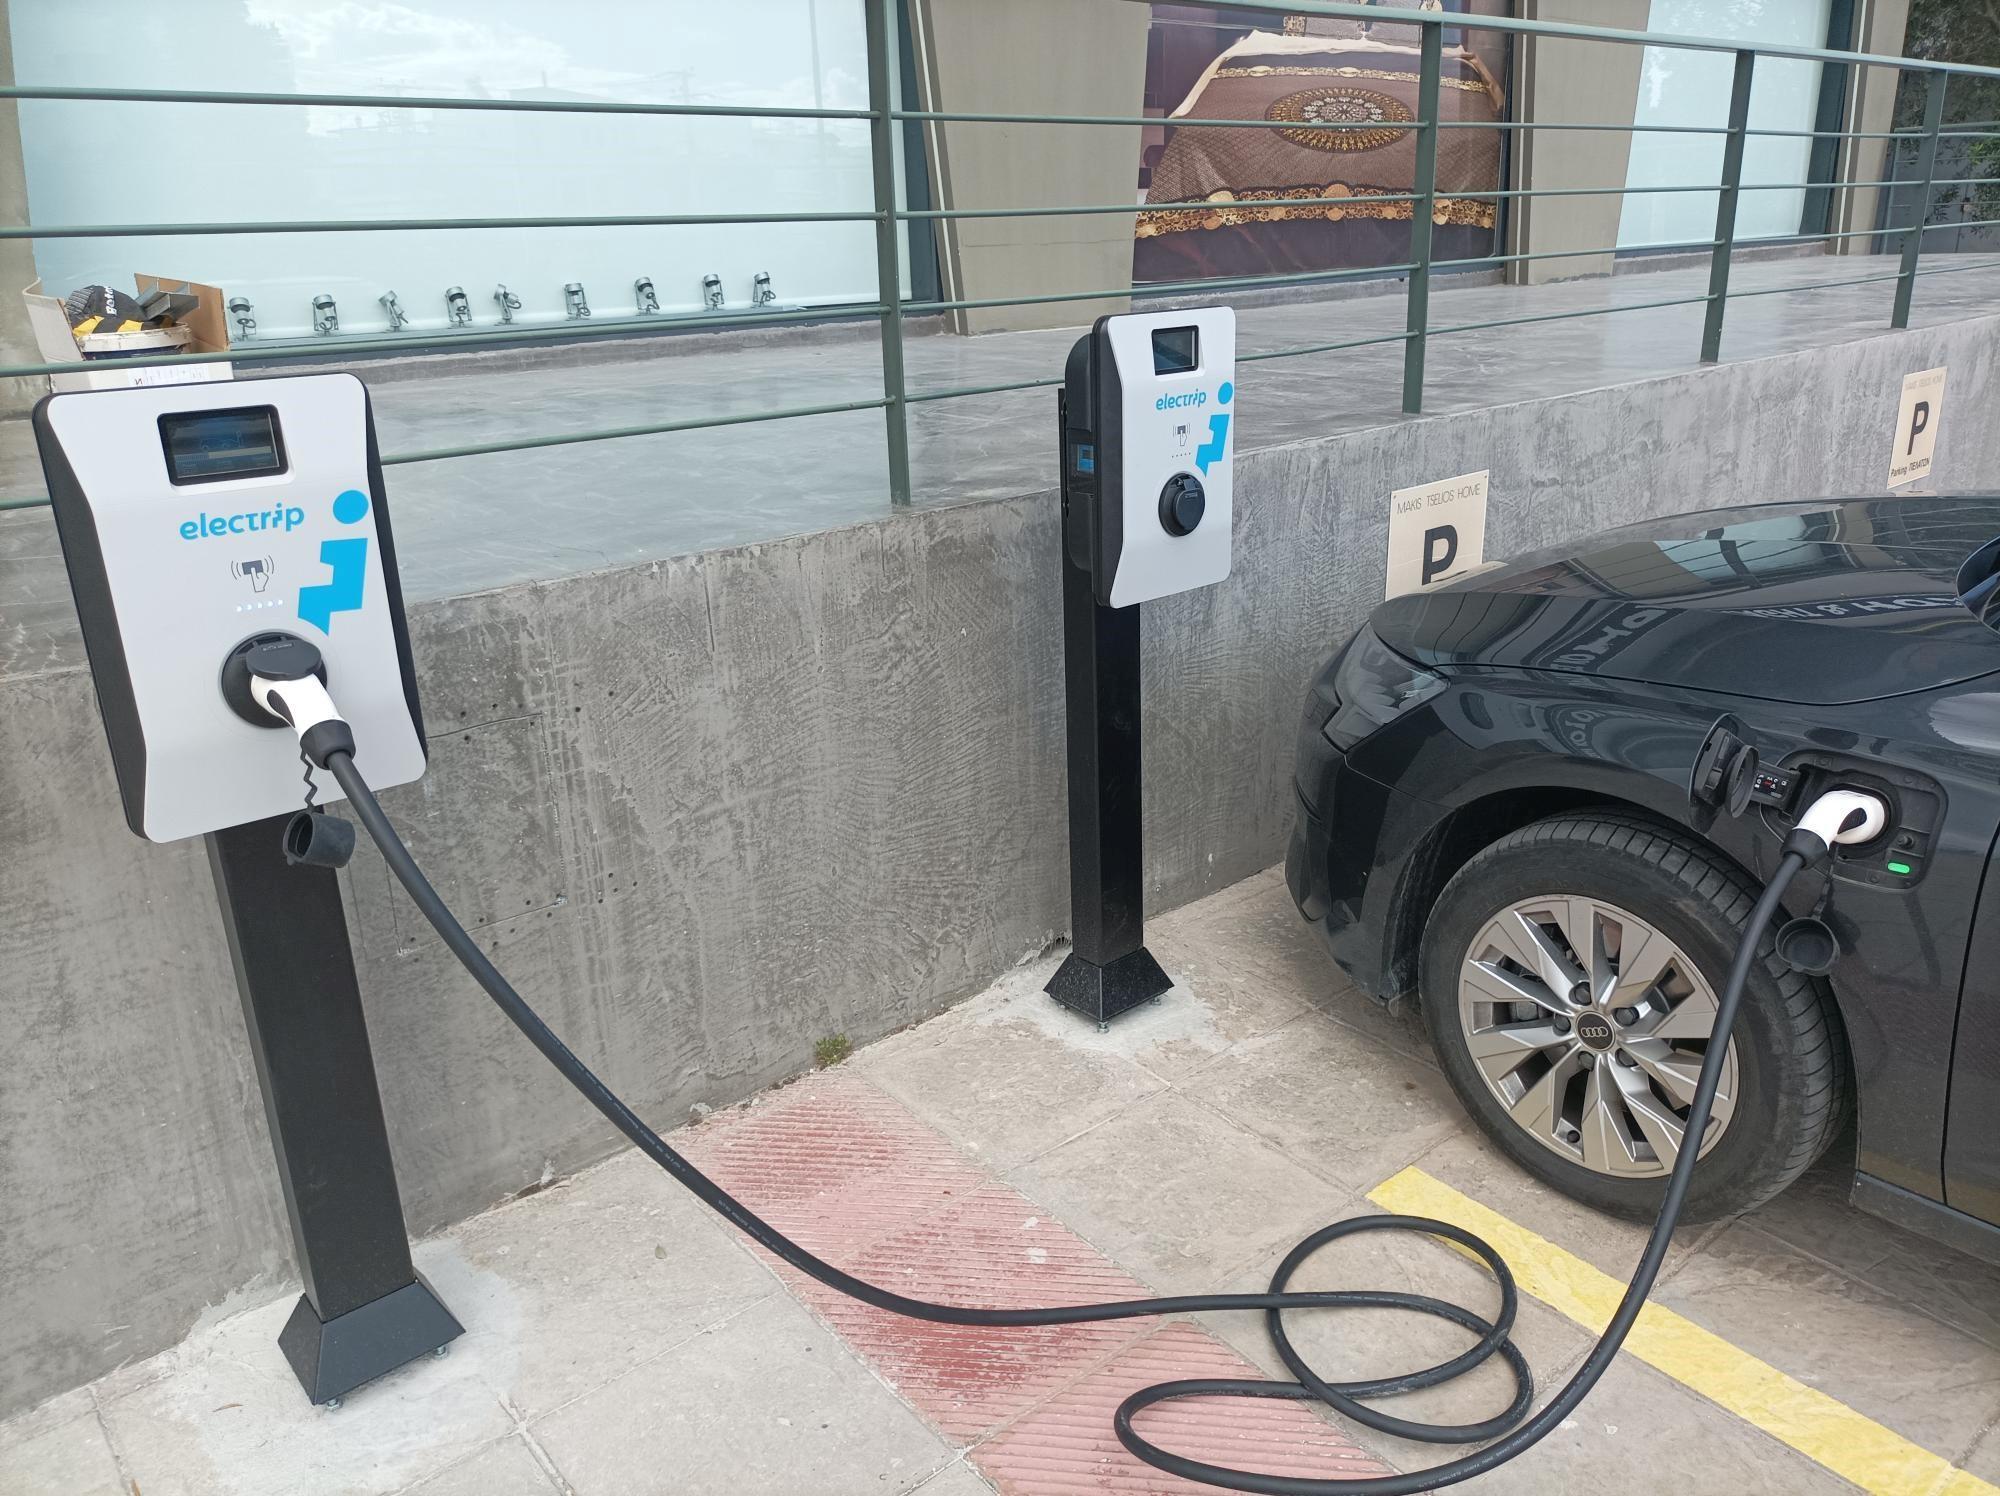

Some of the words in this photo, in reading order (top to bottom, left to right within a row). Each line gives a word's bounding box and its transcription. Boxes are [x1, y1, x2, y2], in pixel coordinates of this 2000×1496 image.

[1156, 389, 1207, 411] electrip
[1907, 401, 1930, 456] P
[1397, 498, 1422, 515] MAKIS
[1457, 483, 1481, 499] HOME
[179, 501, 305, 541] electrip
[1422, 524, 1459, 587] P
